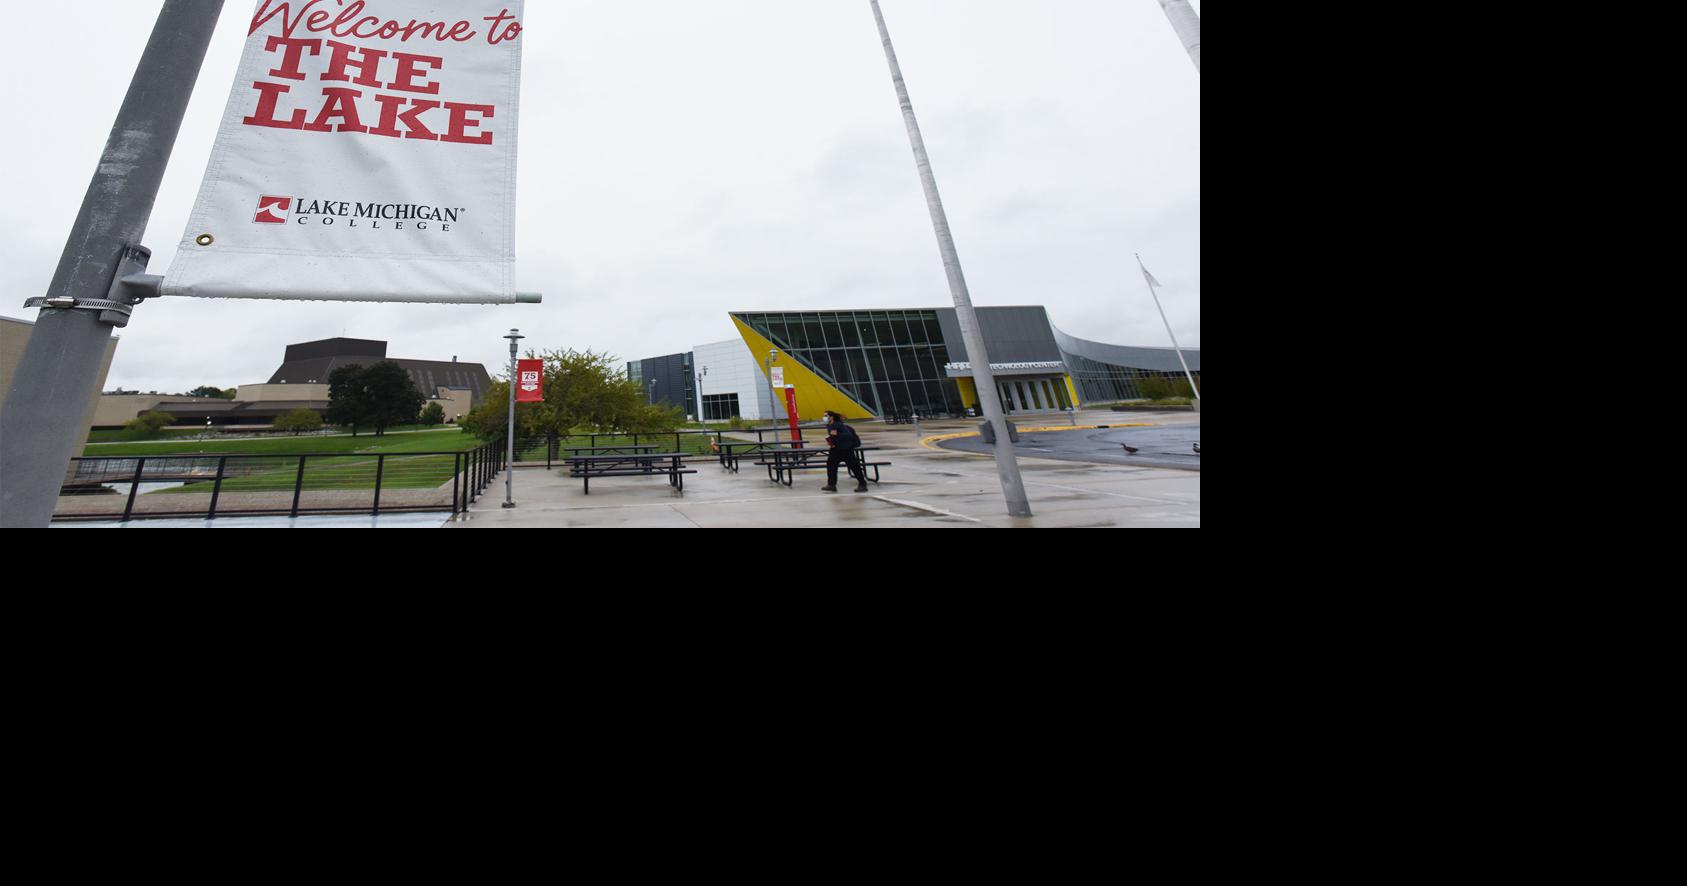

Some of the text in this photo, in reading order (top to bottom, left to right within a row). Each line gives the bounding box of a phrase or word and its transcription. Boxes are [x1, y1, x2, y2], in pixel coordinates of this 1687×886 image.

[247, 0, 523, 45] Welcome to
[264, 35, 443, 95] THE
[242, 81, 495, 145] LAKE
[295, 198, 350, 217] LAKE
[297, 216, 450, 232] COLLEGE
[524, 372, 536, 380] 75
